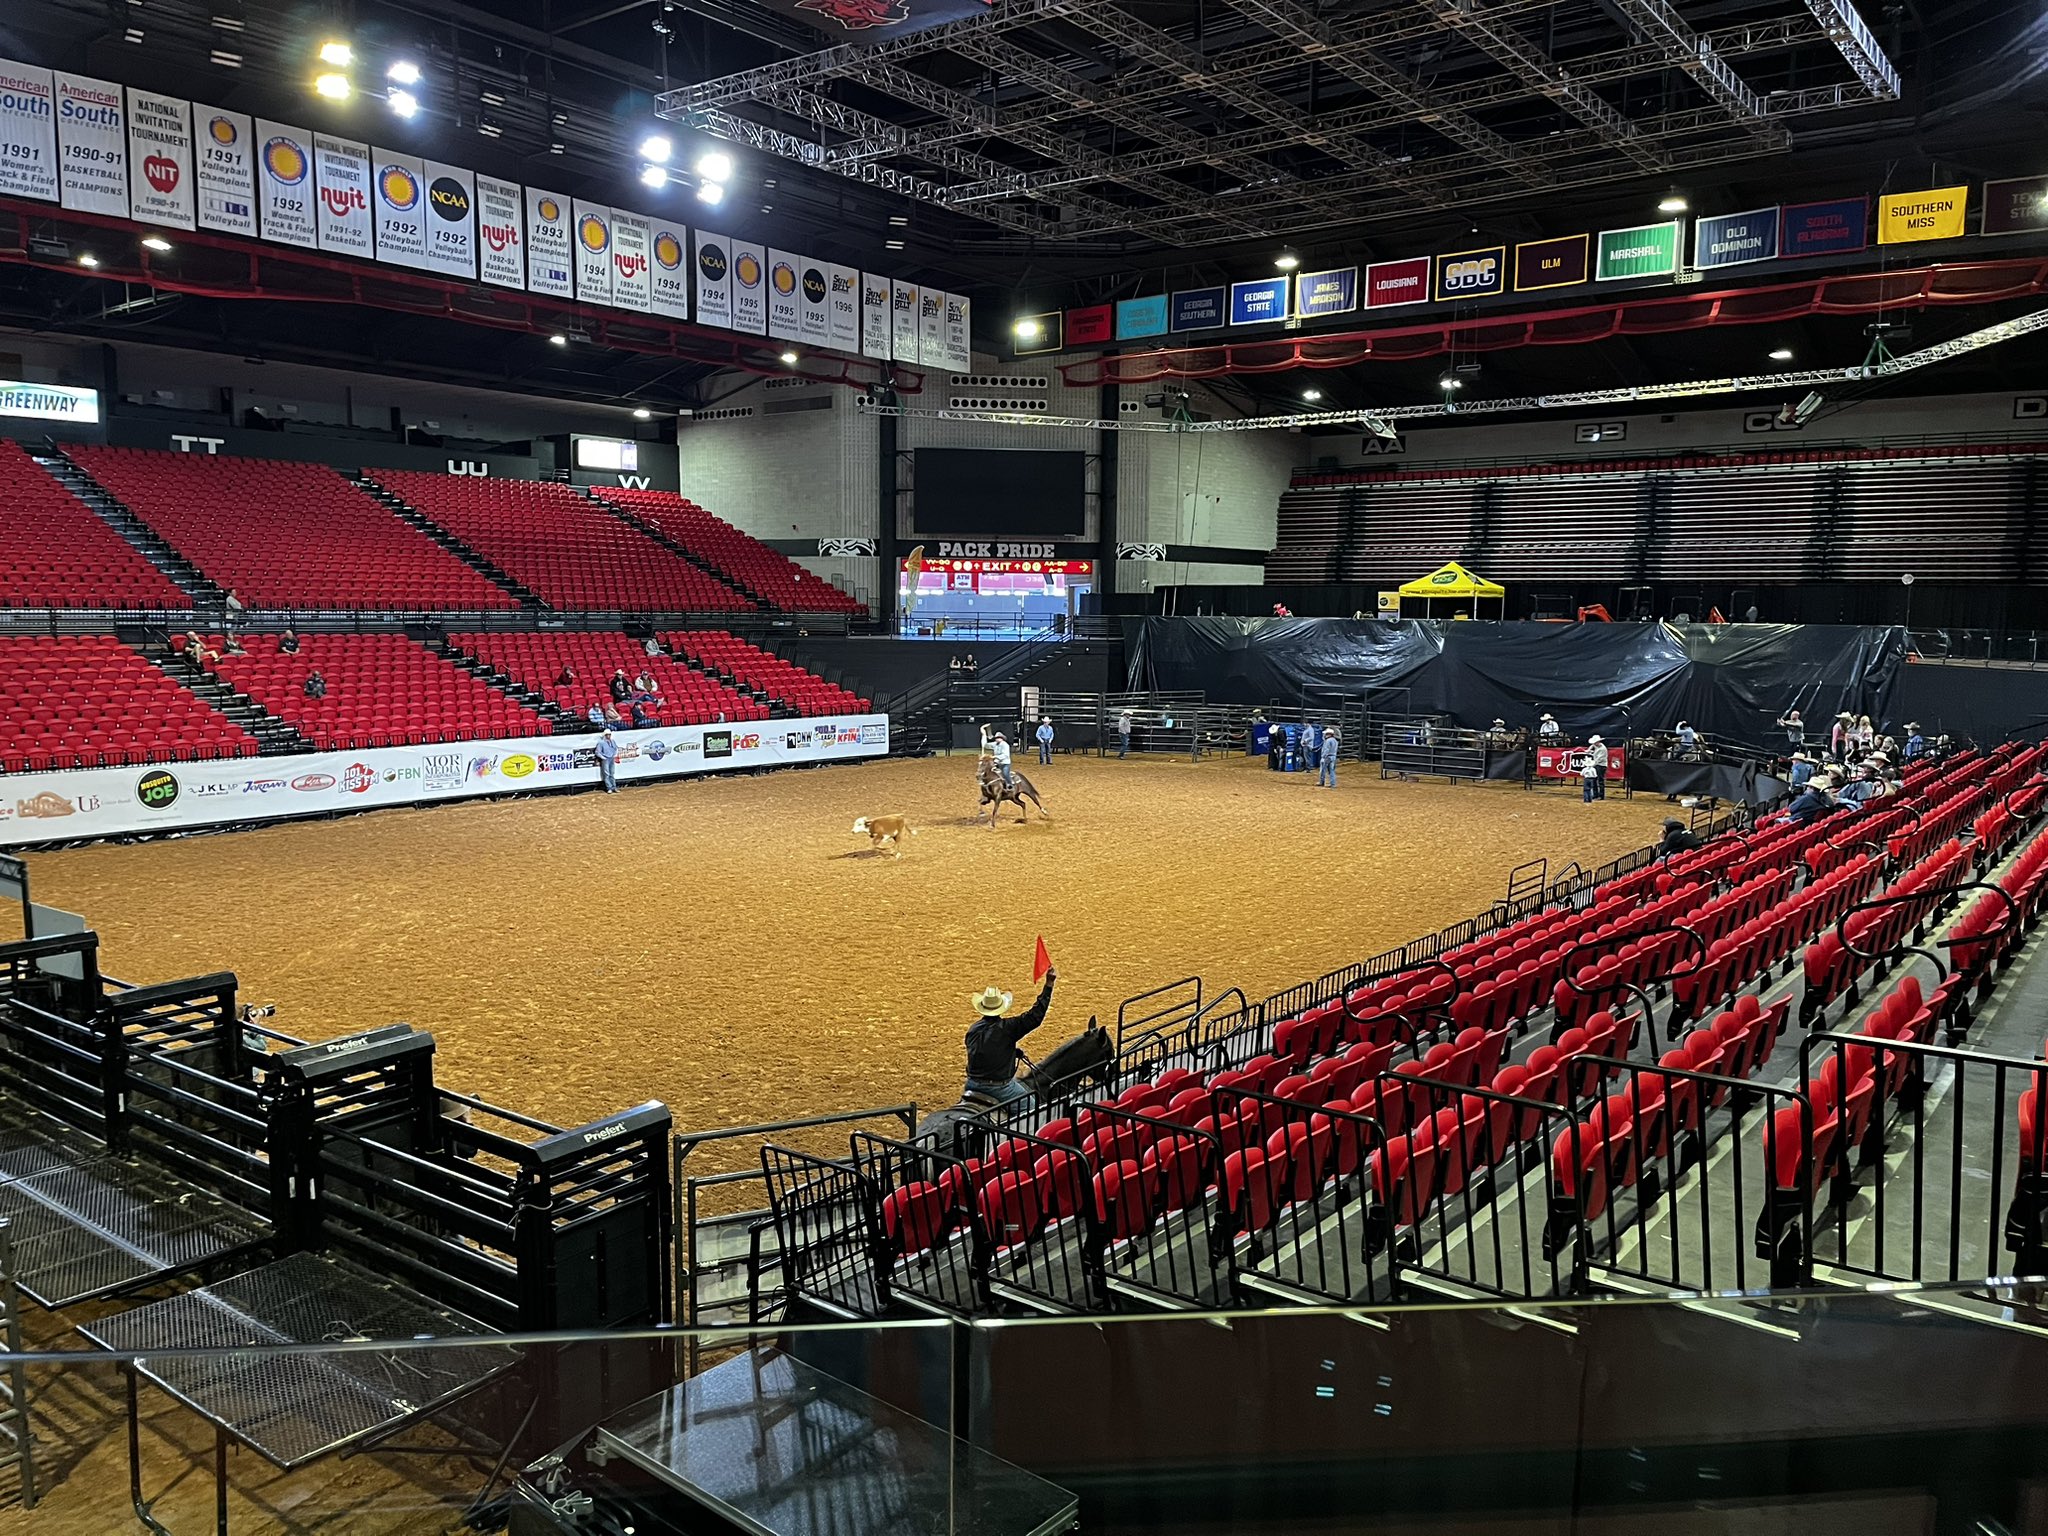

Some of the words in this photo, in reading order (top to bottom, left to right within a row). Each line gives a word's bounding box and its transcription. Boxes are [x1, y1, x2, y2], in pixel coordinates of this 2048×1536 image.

[0, 76, 49, 94] merican
[60, 82, 118, 105] American
[0, 91, 49, 116] outh
[138, 99, 180, 118] NATIONAL
[60, 98, 120, 127] South
[135, 112, 183, 132] INVITATION
[131, 126, 188, 148] TOURNAMENT
[2, 142, 39, 160] 1991
[64, 144, 122, 165] 1990-91
[206, 148, 242, 165] 1991
[1, 158, 44, 174] Women's
[64, 164, 123, 182] BASKETBALL
[148, 163, 177, 182] NIT
[202, 160, 248, 177] Volleyball
[0, 170, 18, 178] ack
[21, 172, 28, 180] &
[31, 174, 56, 186] Field
[199, 172, 250, 189] Champions
[324, 166, 360, 182] TOURNAMENT
[65, 180, 123, 196] CHAMPIONS
[273, 197, 303, 212] 1992
[321, 186, 366, 218] nwit
[431, 190, 468, 208] NCAA
[1891, 201, 1954, 218] SOUTHERN
[204, 213, 250, 228] Volleyball
[272, 210, 306, 224] Women's
[1807, 214, 1842, 228] SOUTH
[1907, 216, 1936, 230] MISS
[264, 218, 284, 228] Track
[295, 224, 314, 234] Field
[385, 220, 417, 236] 1992
[535, 224, 564, 239] 1993
[1726, 226, 1748, 239] OLD
[268, 228, 311, 242] Champions
[324, 234, 366, 248] Basketball
[380, 232, 422, 246] Volleyball
[435, 230, 468, 246] 1992
[482, 224, 518, 252] nwit
[532, 236, 568, 248] Volleyball
[378, 240, 424, 256] Champions
[434, 243, 467, 256] Volleyball
[530, 245, 568, 258] Champions
[1711, 236, 1762, 254] DOMINION
[1610, 245, 1662, 261] MARSHALL
[486, 263, 518, 275] Basketball
[614, 252, 647, 278] nwit
[700, 254, 726, 270] NCAA
[1541, 258, 1562, 270] ULM
[584, 264, 606, 276] 1994
[1445, 258, 1496, 290] SBC
[484, 271, 520, 284] CHAMPIONS
[657, 278, 680, 291] 1994
[834, 274, 849, 284] SUN
[1376, 276, 1418, 290] LOUISIANA
[532, 280, 568, 291] Volleyball
[804, 278, 825, 292] NCAA
[832, 282, 850, 292] BELT
[1314, 281, 1340, 294] JAMES
[702, 288, 725, 300] 1994
[866, 288, 882, 298] SUN
[896, 288, 910, 300] SUN
[1244, 290, 1275, 304] GEORGIA
[740, 298, 758, 308] 1995
[865, 297, 884, 306] BELT
[894, 299, 912, 310] BELT
[923, 296, 938, 308] SUN
[948, 302, 962, 314] SUN
[1246, 300, 1271, 312] STATE
[774, 304, 794, 316] 1995
[806, 311, 825, 322] 1995
[922, 306, 939, 318] BELT
[948, 312, 963, 322] BELT
[1180, 309, 1216, 321] SOUTHERN
[1576, 422, 1626, 442] BB
[172, 434, 224, 454] TT
[1363, 438, 1404, 454] AA
[448, 459, 488, 478] UU
[618, 474, 650, 490] VV
[938, 542, 991, 558] PACK
[996, 543, 1055, 558] PRIDE
[982, 562, 1012, 572] EXIT
[837, 734, 858, 743] KFIN
[426, 755, 460, 767] MOR
[553, 762, 572, 770] WOLF
[345, 764, 370, 780] 101.7
[397, 767, 420, 780] FBN
[426, 766, 460, 776] MEDIA
[140, 776, 172, 790] MOSQUITO
[242, 780, 288, 794] JORDAN'S
[338, 778, 362, 794] KISS
[363, 772, 380, 787] FM
[144, 784, 175, 803] JOE
[584, 1122, 627, 1142] Priefert
